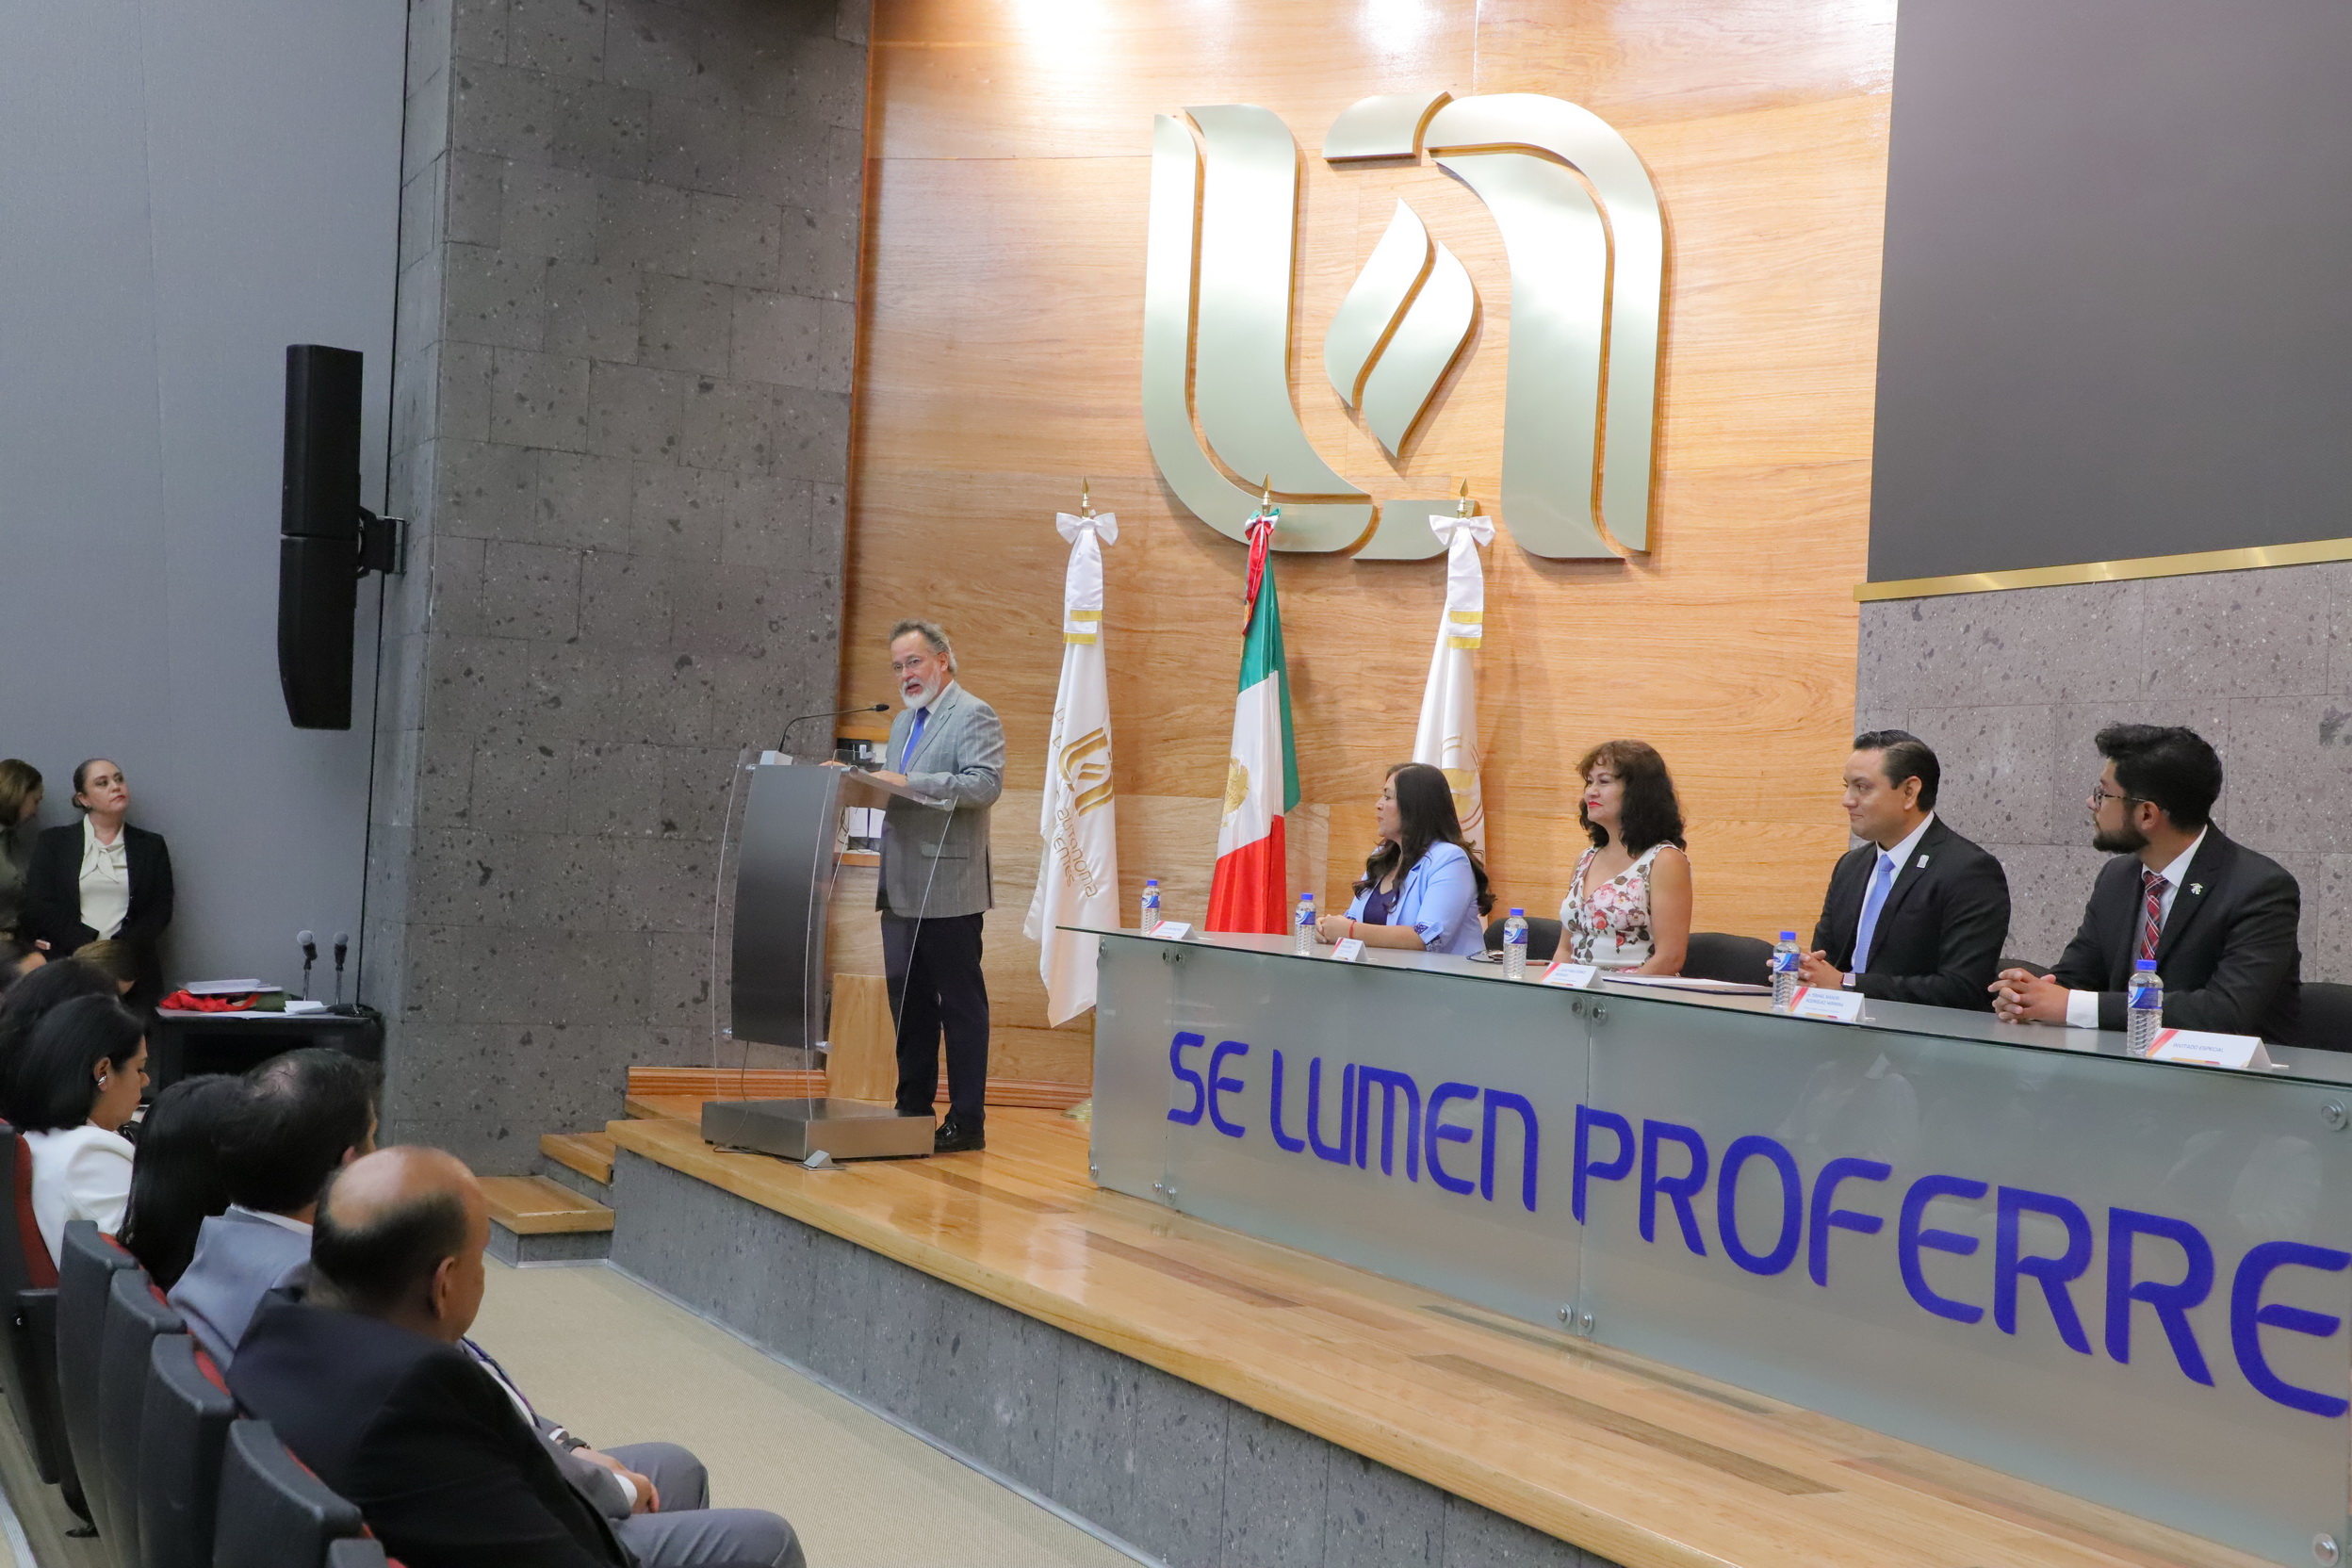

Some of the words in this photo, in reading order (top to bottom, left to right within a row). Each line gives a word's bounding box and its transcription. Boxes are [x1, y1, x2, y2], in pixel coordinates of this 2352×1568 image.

[1167, 1031, 1250, 1138] SE
[1270, 1049, 1539, 1213] LUMEN
[1572, 1103, 2352, 1418] PROFERRE
